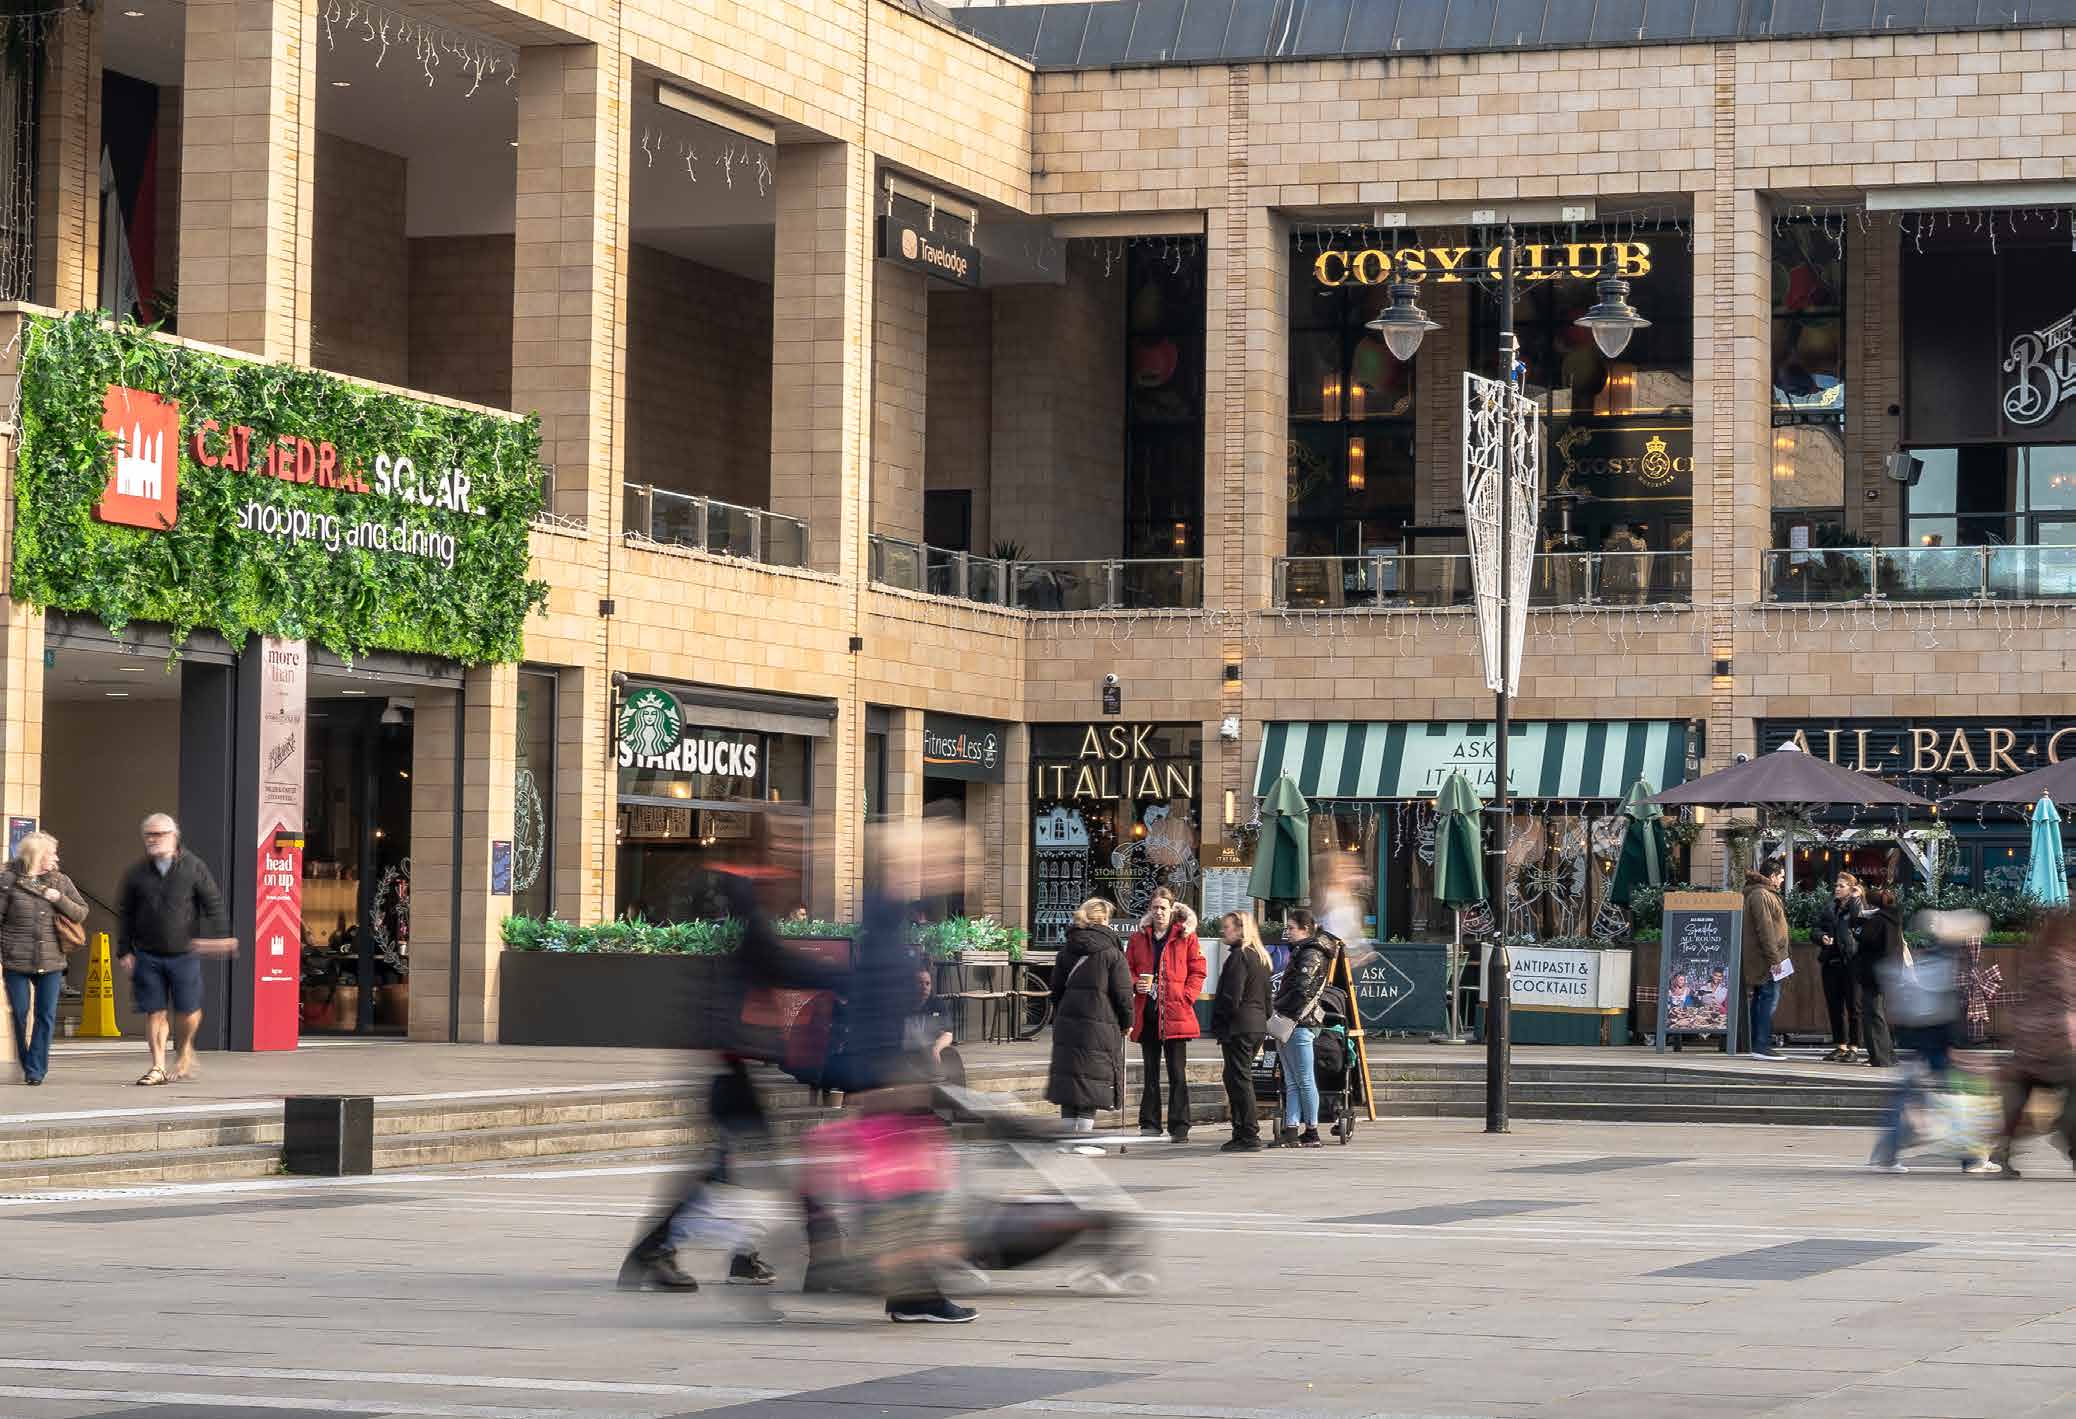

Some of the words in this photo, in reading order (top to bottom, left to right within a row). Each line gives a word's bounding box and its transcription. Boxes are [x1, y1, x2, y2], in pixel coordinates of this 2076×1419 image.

[919, 237, 967, 277] Travelodge
[1315, 248, 1472, 287] COSY
[1487, 242, 1651, 280] CLUB
[375, 451, 486, 515] SQAR
[237, 498, 339, 551] shopping
[346, 521, 387, 549] and
[393, 518, 455, 569] dning
[269, 650, 299, 665] more
[924, 729, 982, 760] Fitness4Less
[1079, 725, 1154, 760] ASK
[1453, 741, 1496, 758] ASK
[1908, 728, 2026, 773] BAR
[1035, 764, 1193, 799] ITALIAN
[266, 852, 293, 871] head
[264, 874, 276, 886] on
[278, 874, 294, 892] up
[1362, 968, 1386, 980] ASK
[1515, 960, 1575, 974] ANTIPASTI
[1578, 962, 1588, 975] &
[1354, 985, 1398, 998] TALIAN
[1512, 980, 1587, 995] COCKTAILS
